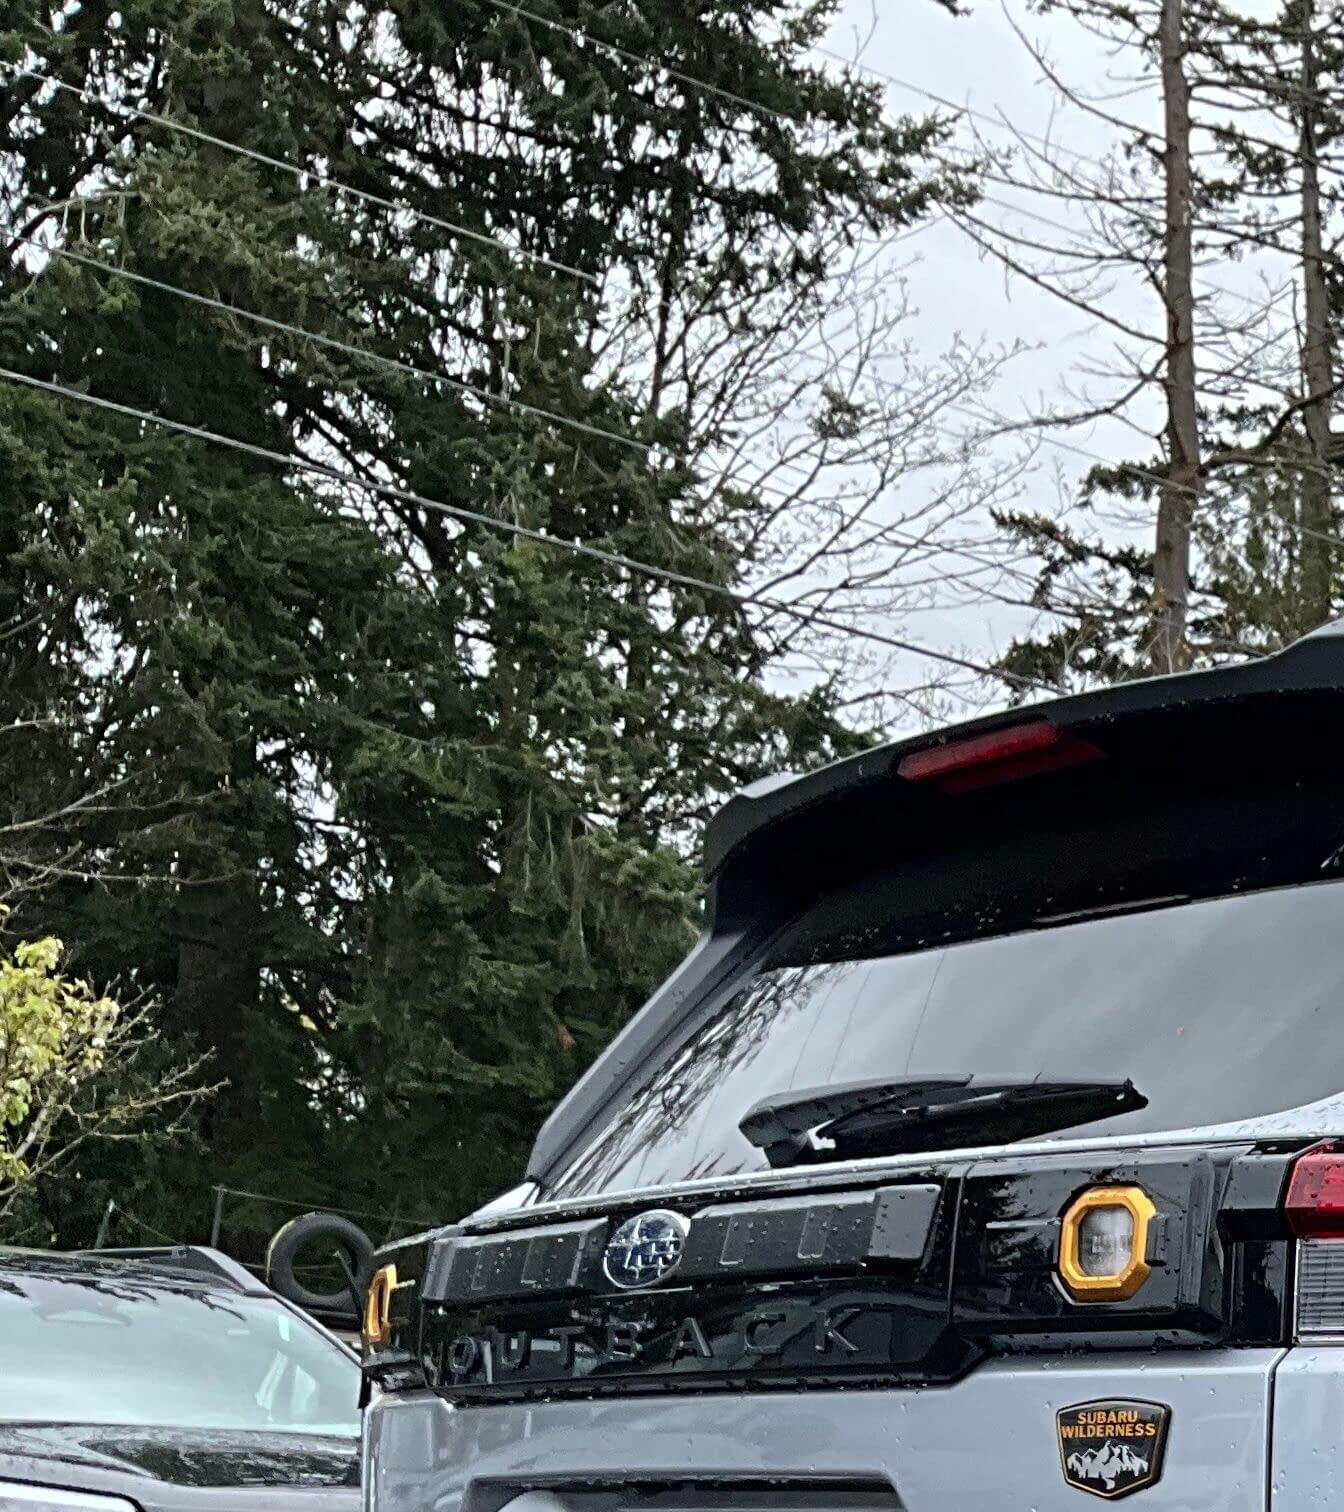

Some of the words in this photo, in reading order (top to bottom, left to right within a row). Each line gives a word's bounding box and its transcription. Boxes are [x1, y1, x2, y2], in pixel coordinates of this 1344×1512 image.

[448, 1308, 864, 1377] OUTBACK
[1077, 1410, 1138, 1424] SUBARU
[1061, 1423, 1156, 1438] WILDERNESS
